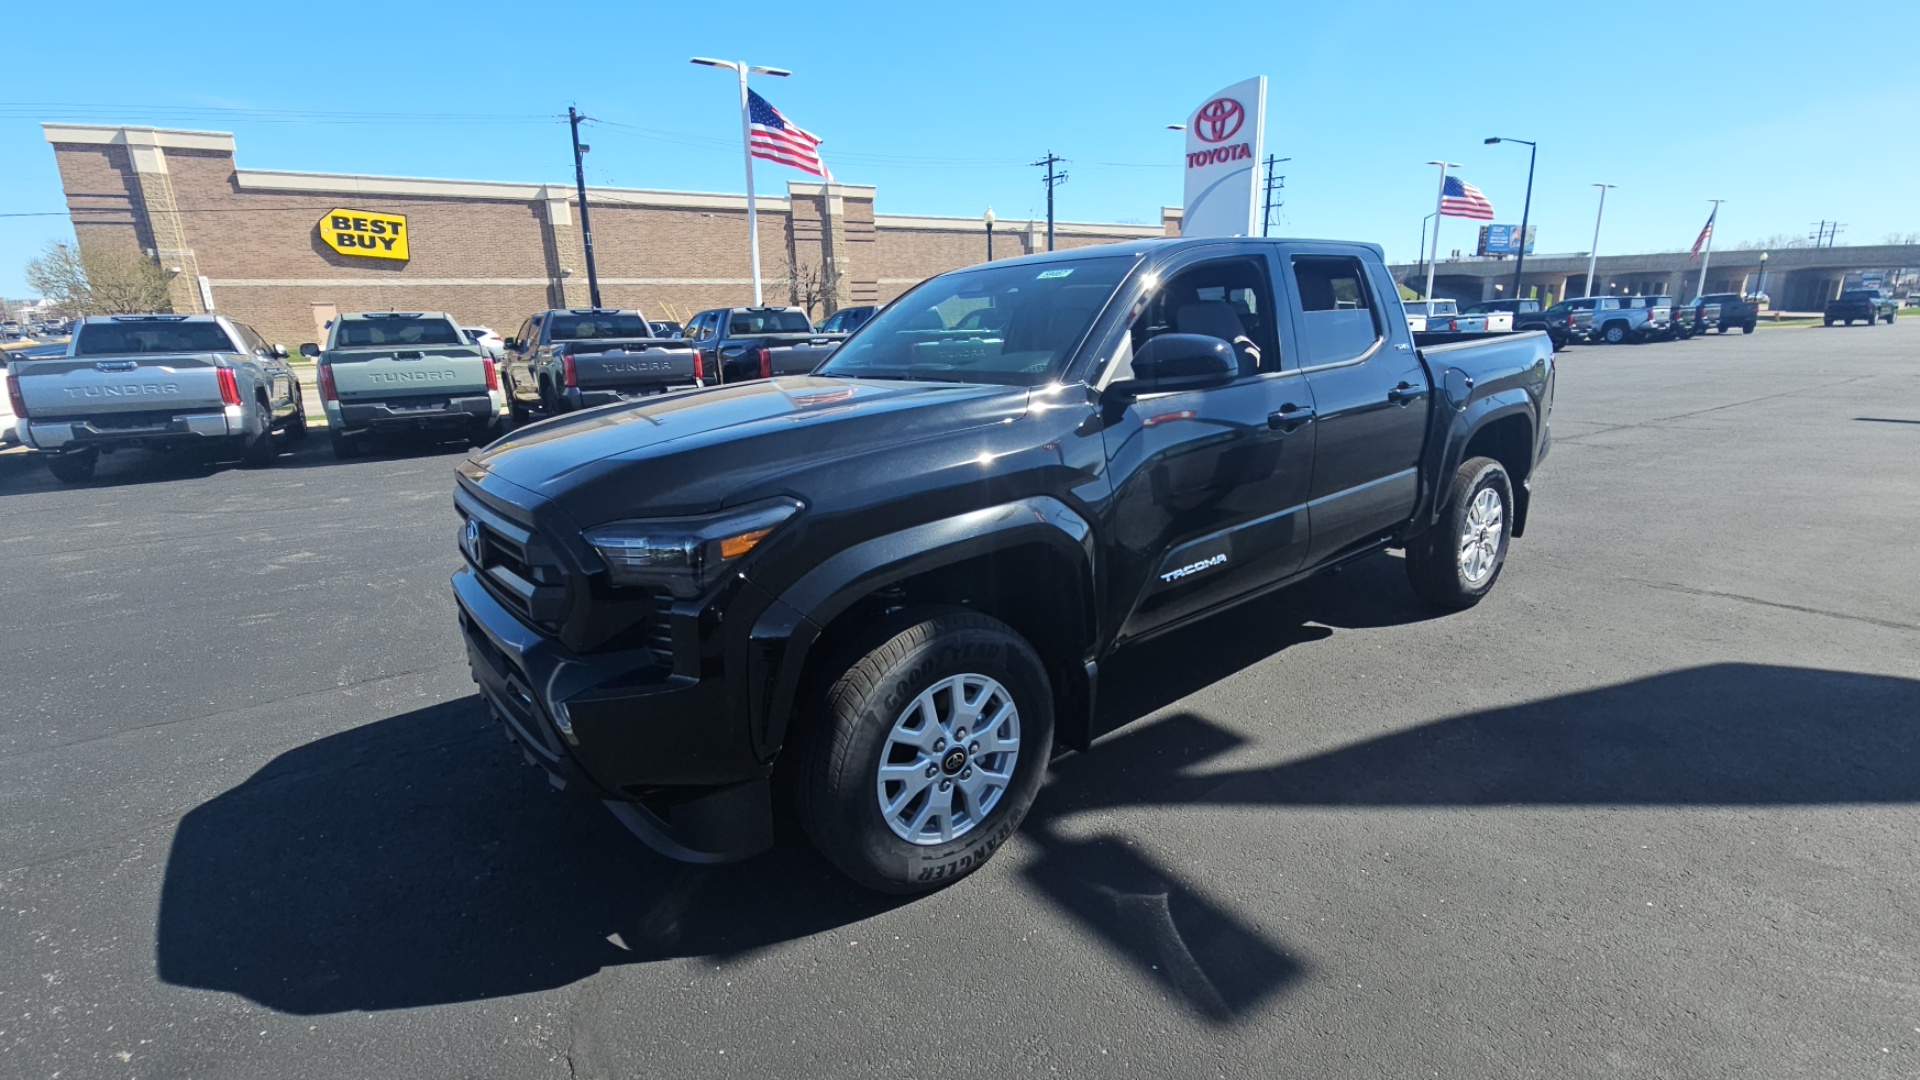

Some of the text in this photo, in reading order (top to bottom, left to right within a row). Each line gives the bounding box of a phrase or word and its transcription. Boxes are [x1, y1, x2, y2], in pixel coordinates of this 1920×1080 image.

[1186, 143, 1252, 168] TOYOTA
[331, 215, 403, 236] BEST
[336, 232, 398, 251] BUY
[367, 369, 457, 384] TUNDRA
[601, 361, 672, 373] TUNDRA
[63, 382, 181, 399] TUNDRA
[1160, 553, 1227, 582] TACOMA
[918, 806, 1023, 881] WRANGLER
